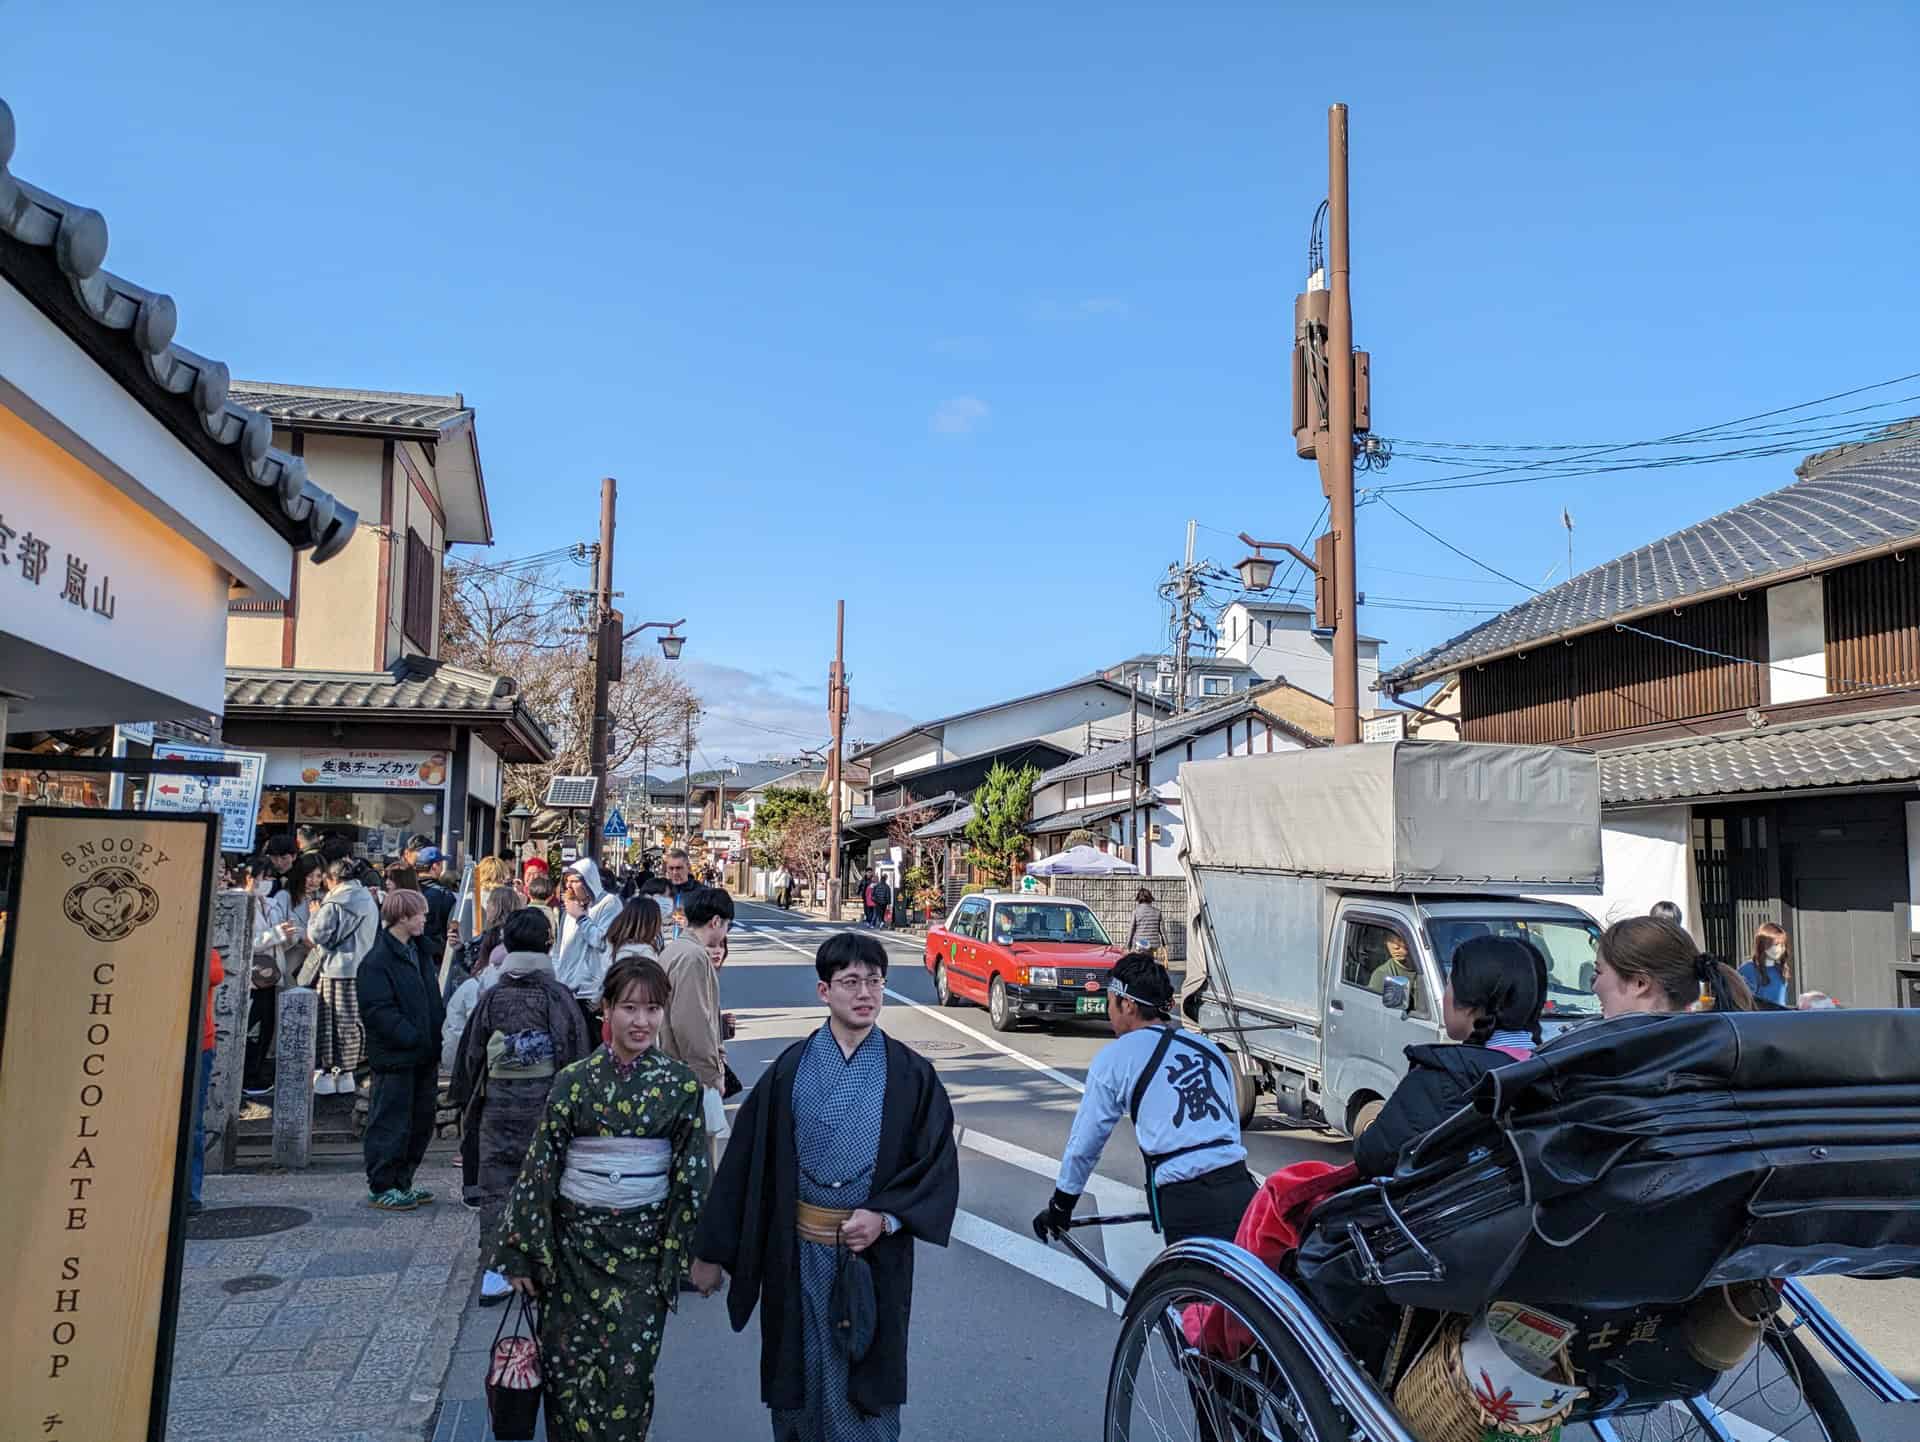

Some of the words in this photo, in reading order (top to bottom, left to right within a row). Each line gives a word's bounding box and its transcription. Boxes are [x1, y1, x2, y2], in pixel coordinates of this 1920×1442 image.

[60, 553, 116, 620] 嵐山
[61, 838, 170, 868] SNOOPY
[65, 962, 115, 1231] CHOCOLATE
[1165, 1053, 1234, 1129] 嵐
[48, 1256, 80, 1378] SHOP
[42, 1412, 64, 1442] チ
